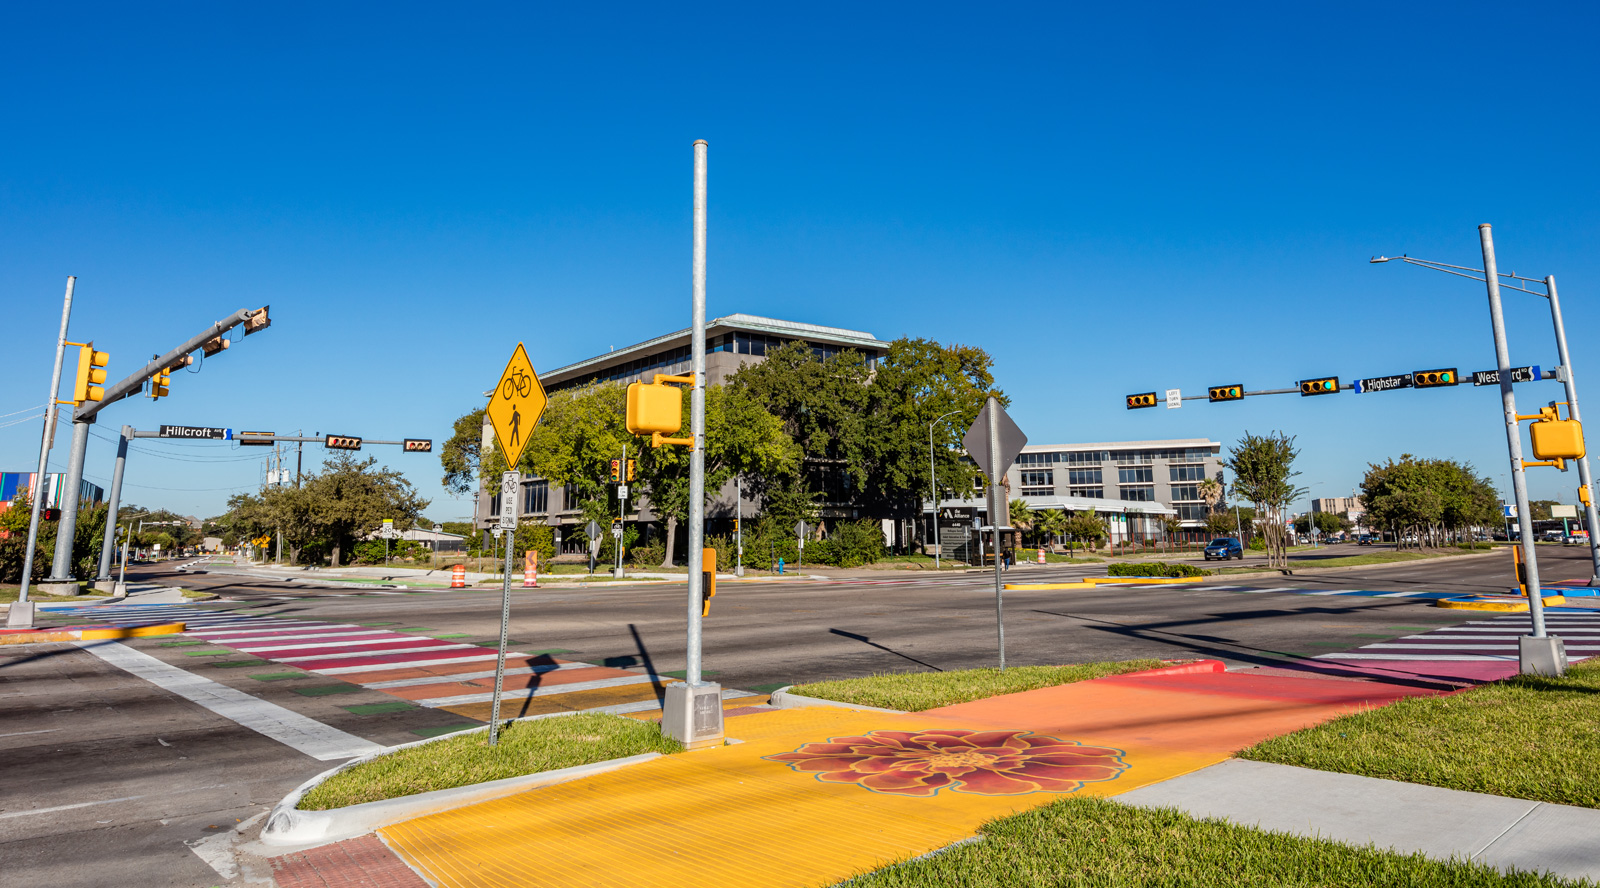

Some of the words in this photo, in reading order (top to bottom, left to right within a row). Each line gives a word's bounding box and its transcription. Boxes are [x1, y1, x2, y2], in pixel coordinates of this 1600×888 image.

[1477, 369, 1522, 384] Westrd
[1367, 377, 1401, 391] Highstar
[166, 425, 211, 437] Hillcroft
[505, 506, 513, 515] PED
[502, 516, 515, 525] SIGNAL
